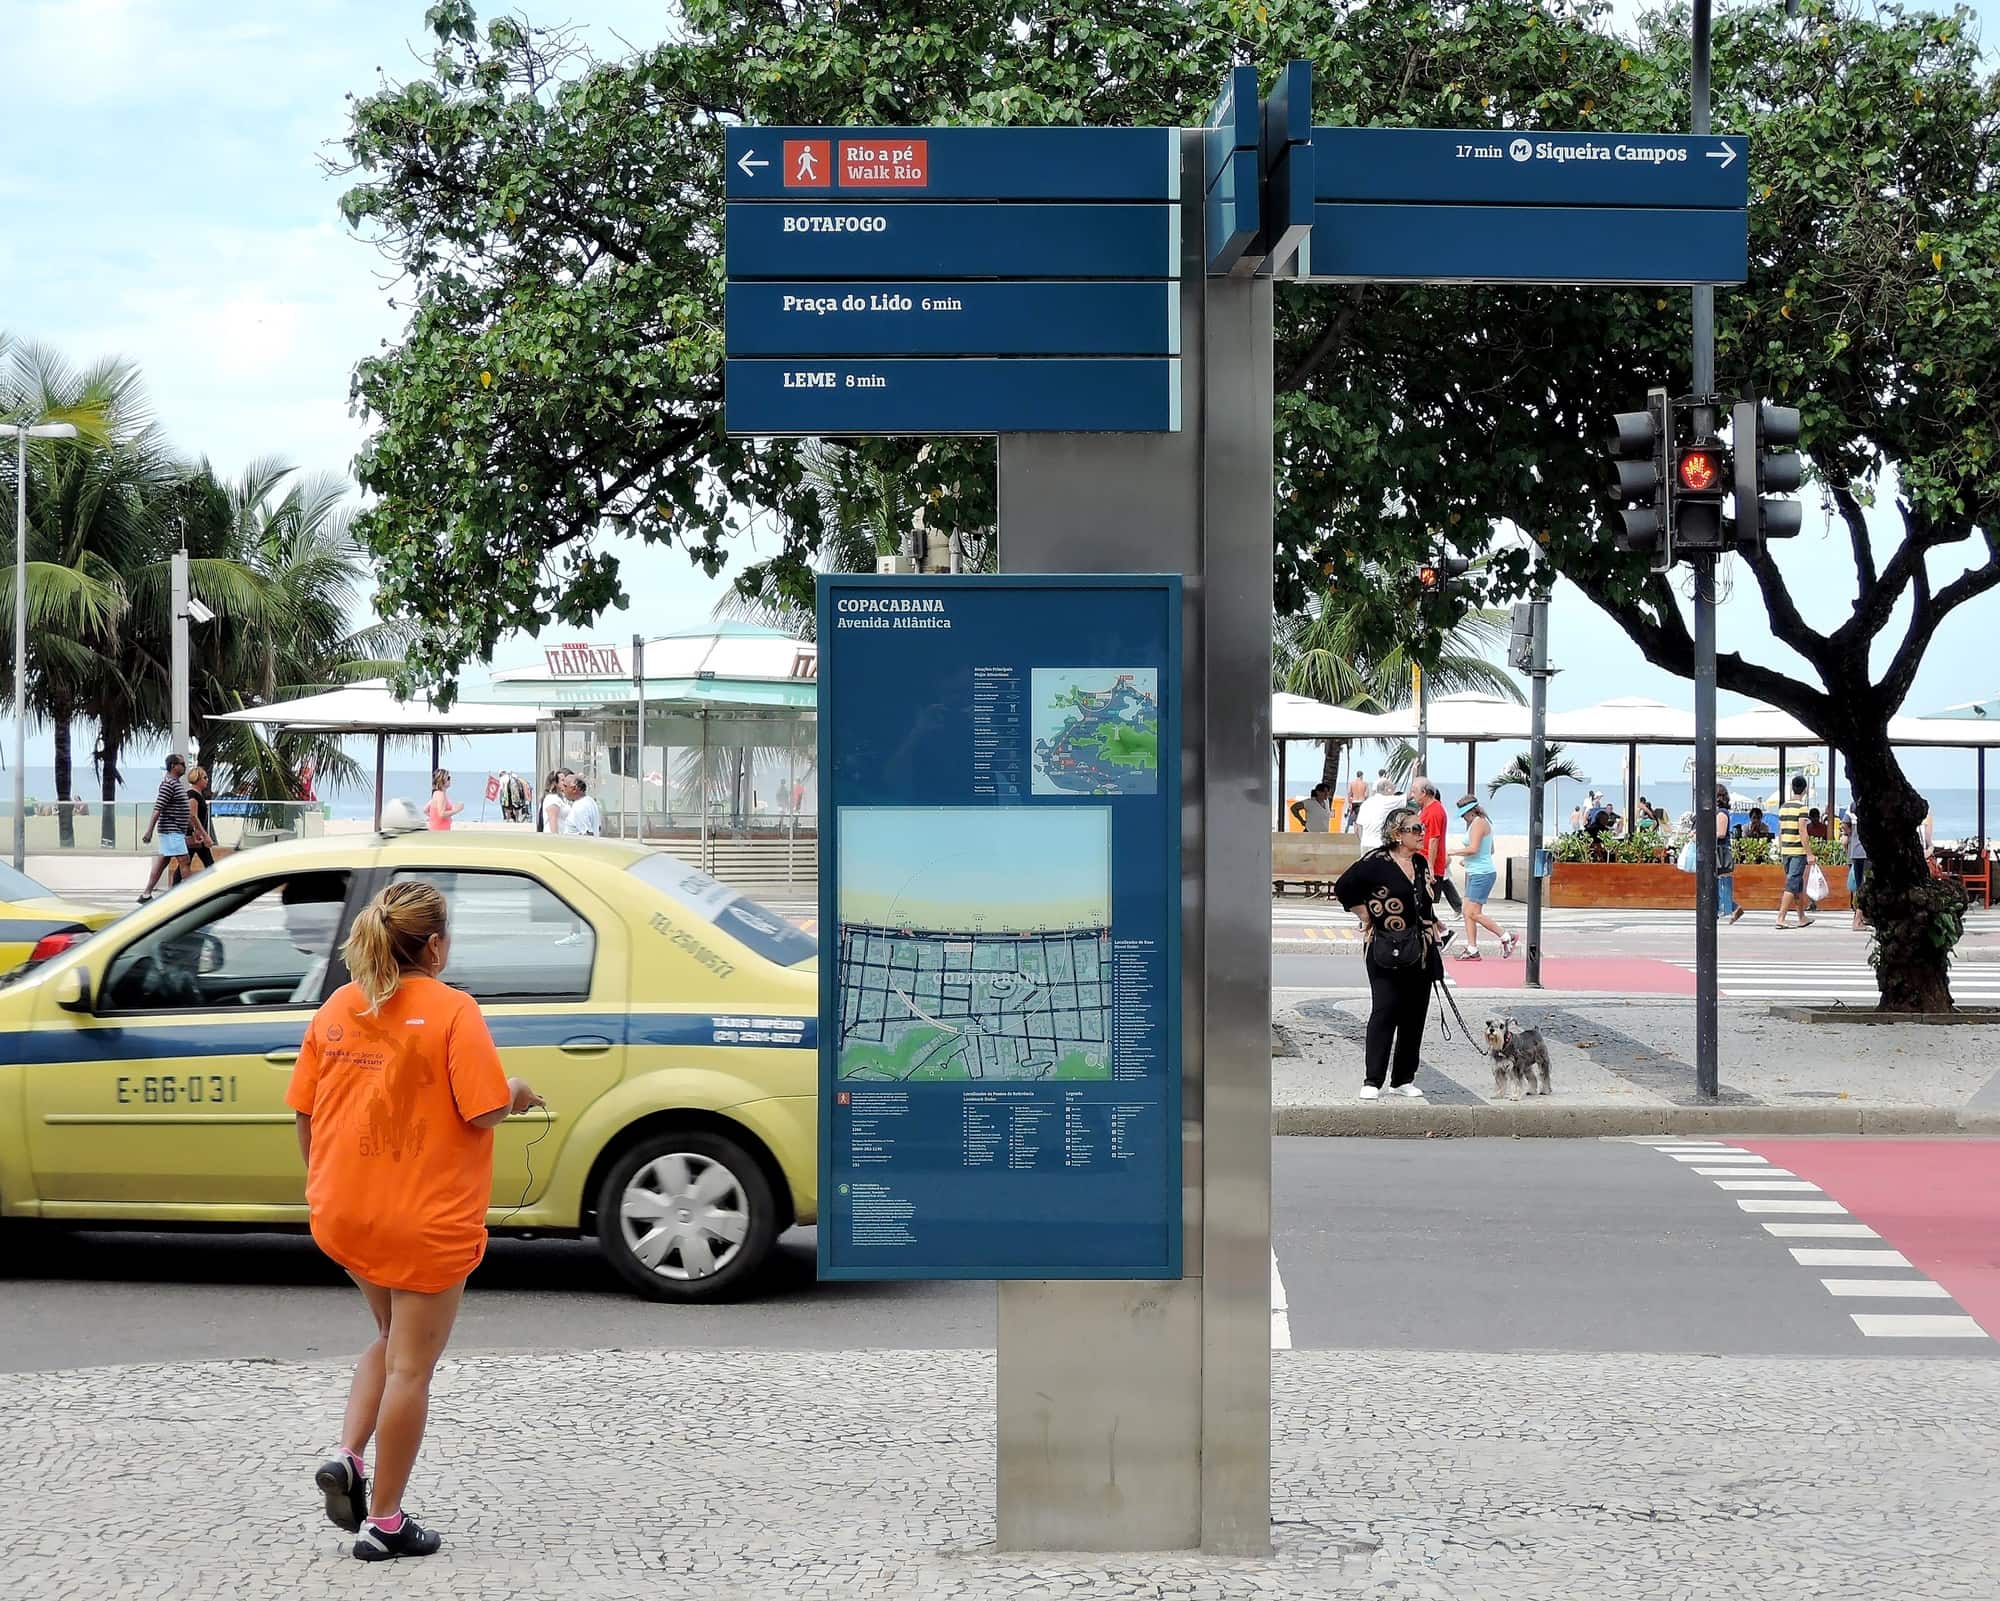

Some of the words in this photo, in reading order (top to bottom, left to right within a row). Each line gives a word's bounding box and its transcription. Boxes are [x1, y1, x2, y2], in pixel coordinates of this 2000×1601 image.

[846, 145, 875, 161] Rio
[878, 149, 889, 161] a
[891, 145, 913, 165] pé
[1535, 142, 1611, 163] Siqueira
[1614, 145, 1688, 165] Campos
[847, 164, 890, 180] Walk
[894, 164, 922, 180] Rio
[783, 216, 887, 233] BOTAFOGO
[783, 295, 838, 316] Praça
[841, 294, 866, 311] do
[870, 294, 913, 311] Lido
[783, 372, 837, 388] LEME
[837, 599, 945, 612] COPACABANA
[837, 616, 890, 629] Avenida
[892, 616, 952, 629] Atlântica
[545, 649, 624, 674] ITAIPAVA
[117, 1075, 237, 1104] E-66-031
